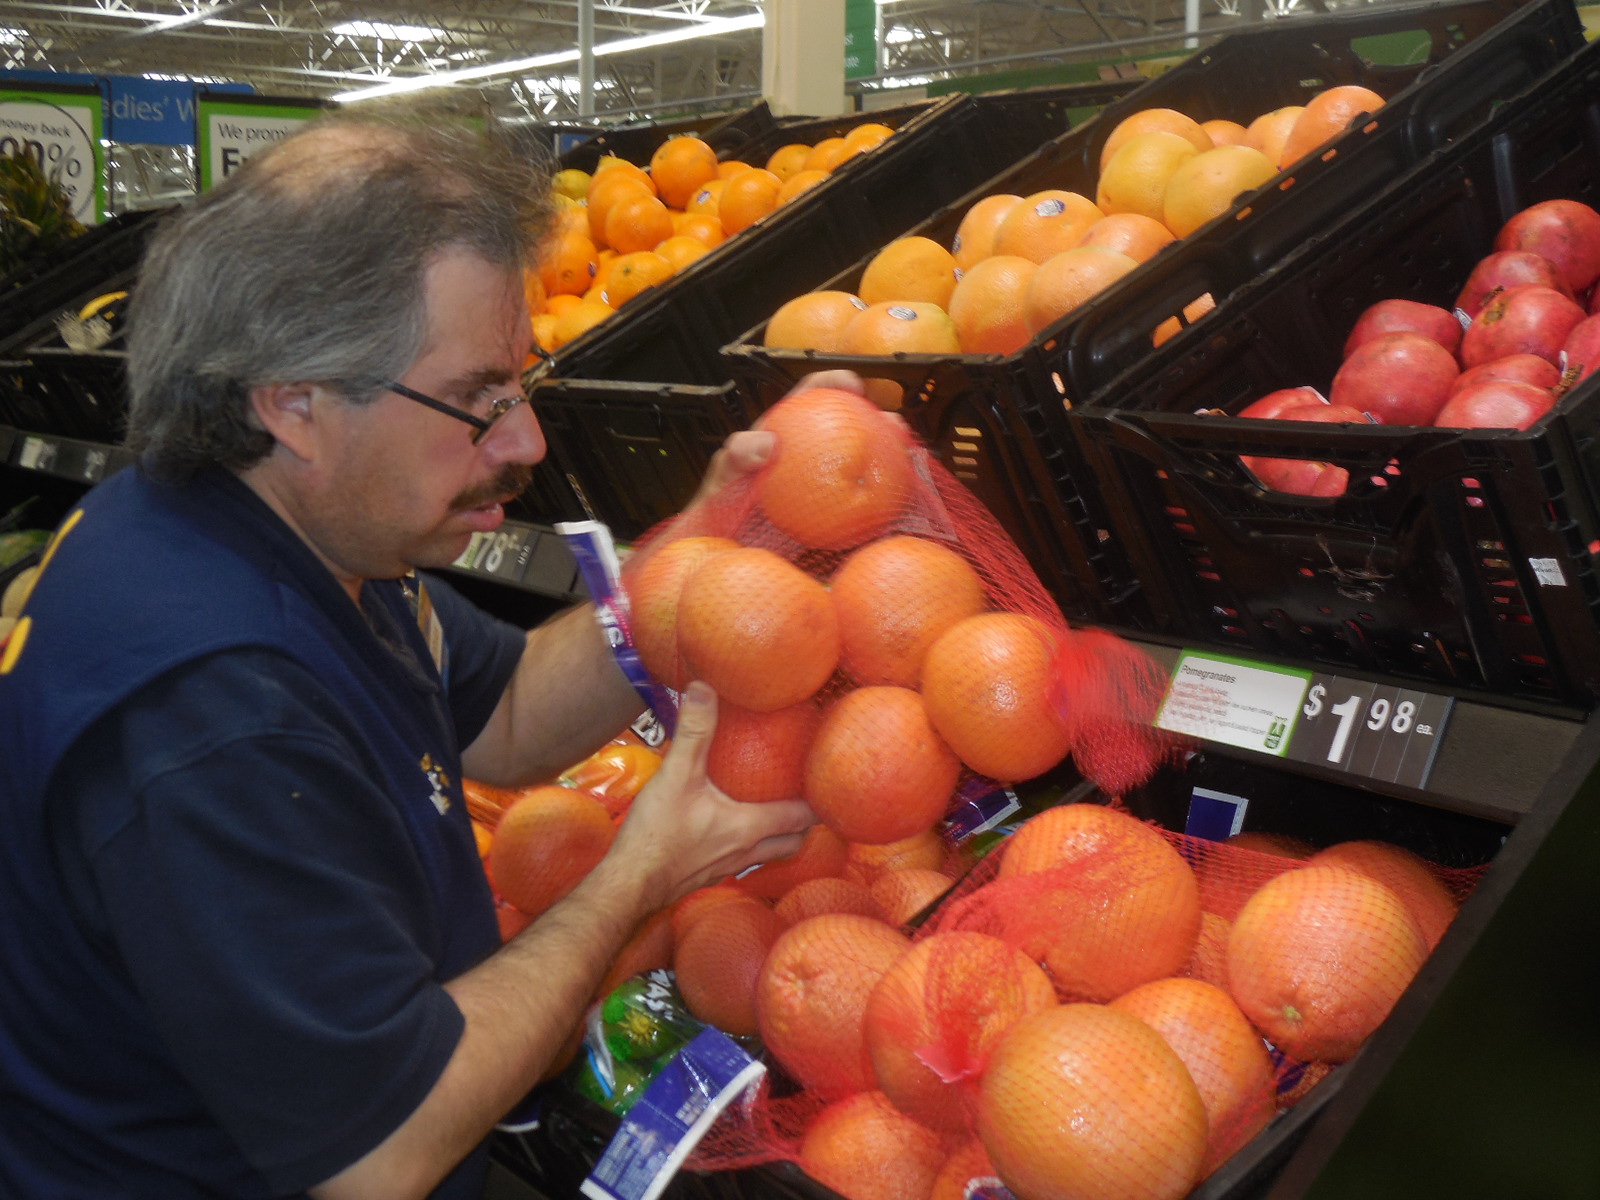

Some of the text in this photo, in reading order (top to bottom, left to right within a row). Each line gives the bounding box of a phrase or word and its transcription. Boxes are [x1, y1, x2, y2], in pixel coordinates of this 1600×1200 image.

[40, 121, 72, 138] back
[217, 122, 290, 144] We promi
[1181, 664, 1236, 684] Pomegranates
